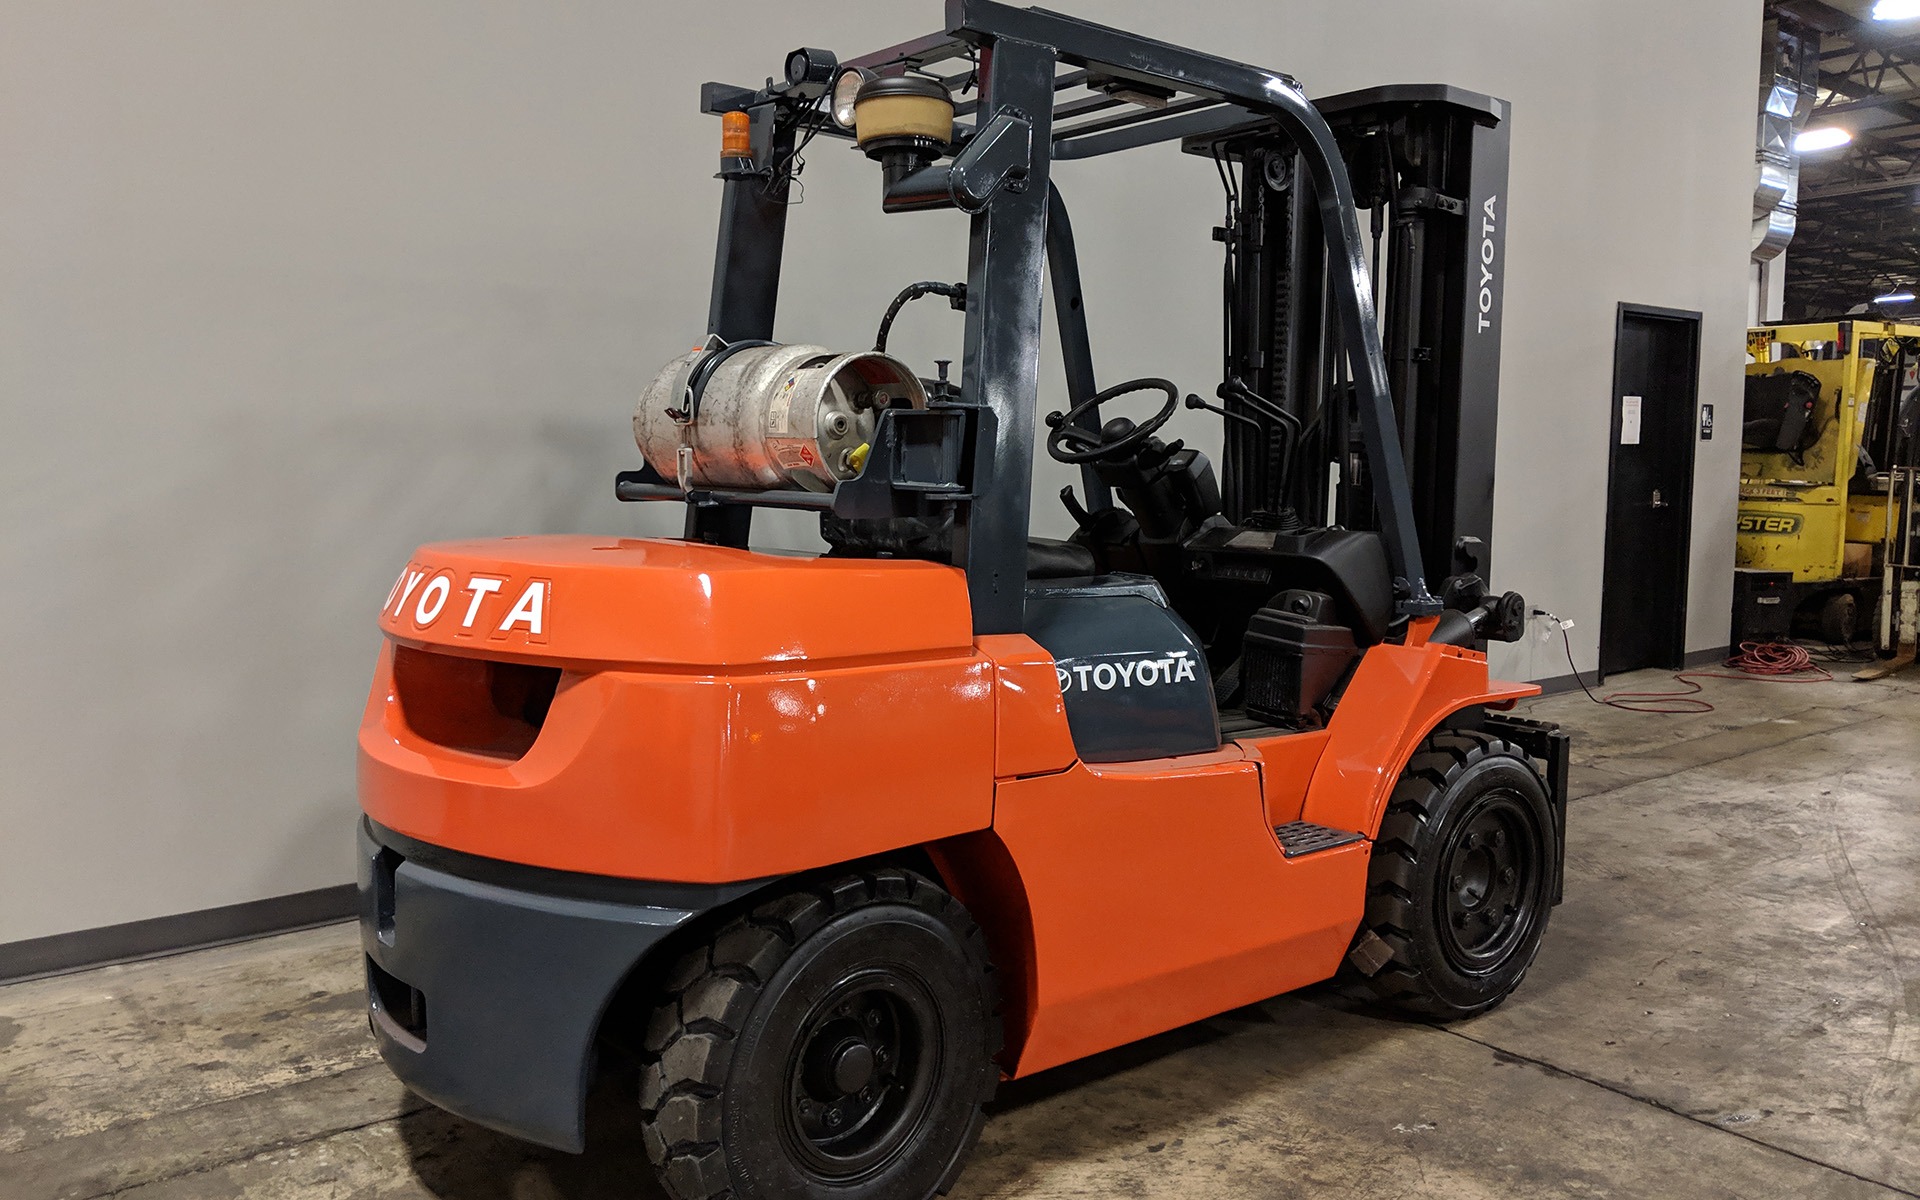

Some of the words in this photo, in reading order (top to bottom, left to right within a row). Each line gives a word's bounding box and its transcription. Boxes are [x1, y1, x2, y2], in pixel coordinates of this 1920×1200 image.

[1477, 194, 1497, 334] TOYOTA
[1737, 516, 1795, 532] STER
[383, 566, 546, 635] OYOTA
[1072, 657, 1196, 692] TOYOTA
